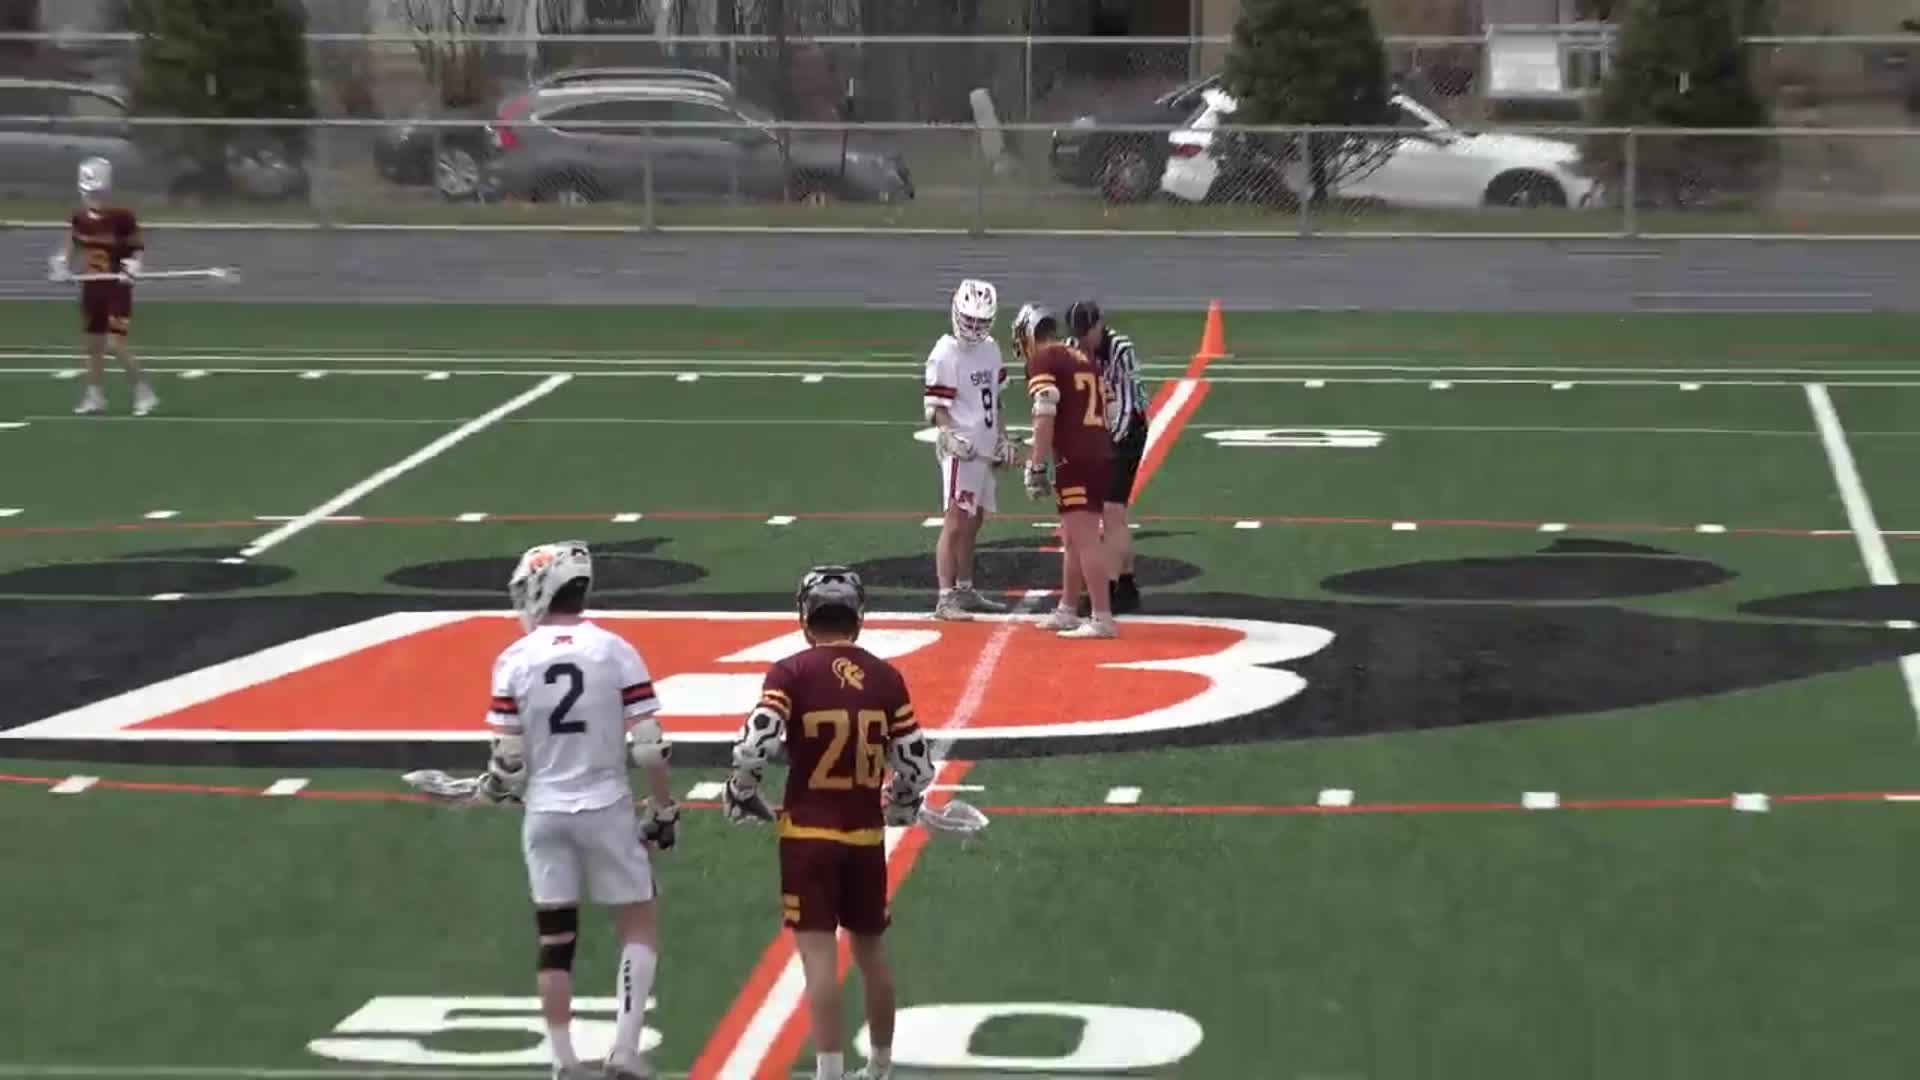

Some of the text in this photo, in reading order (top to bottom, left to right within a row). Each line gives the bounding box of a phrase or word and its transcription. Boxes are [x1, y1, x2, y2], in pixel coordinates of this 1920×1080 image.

[981, 387, 994, 429] 9
[1072, 372, 1105, 426] 2
[544, 662, 588, 734] 2
[802, 708, 888, 790] 26
